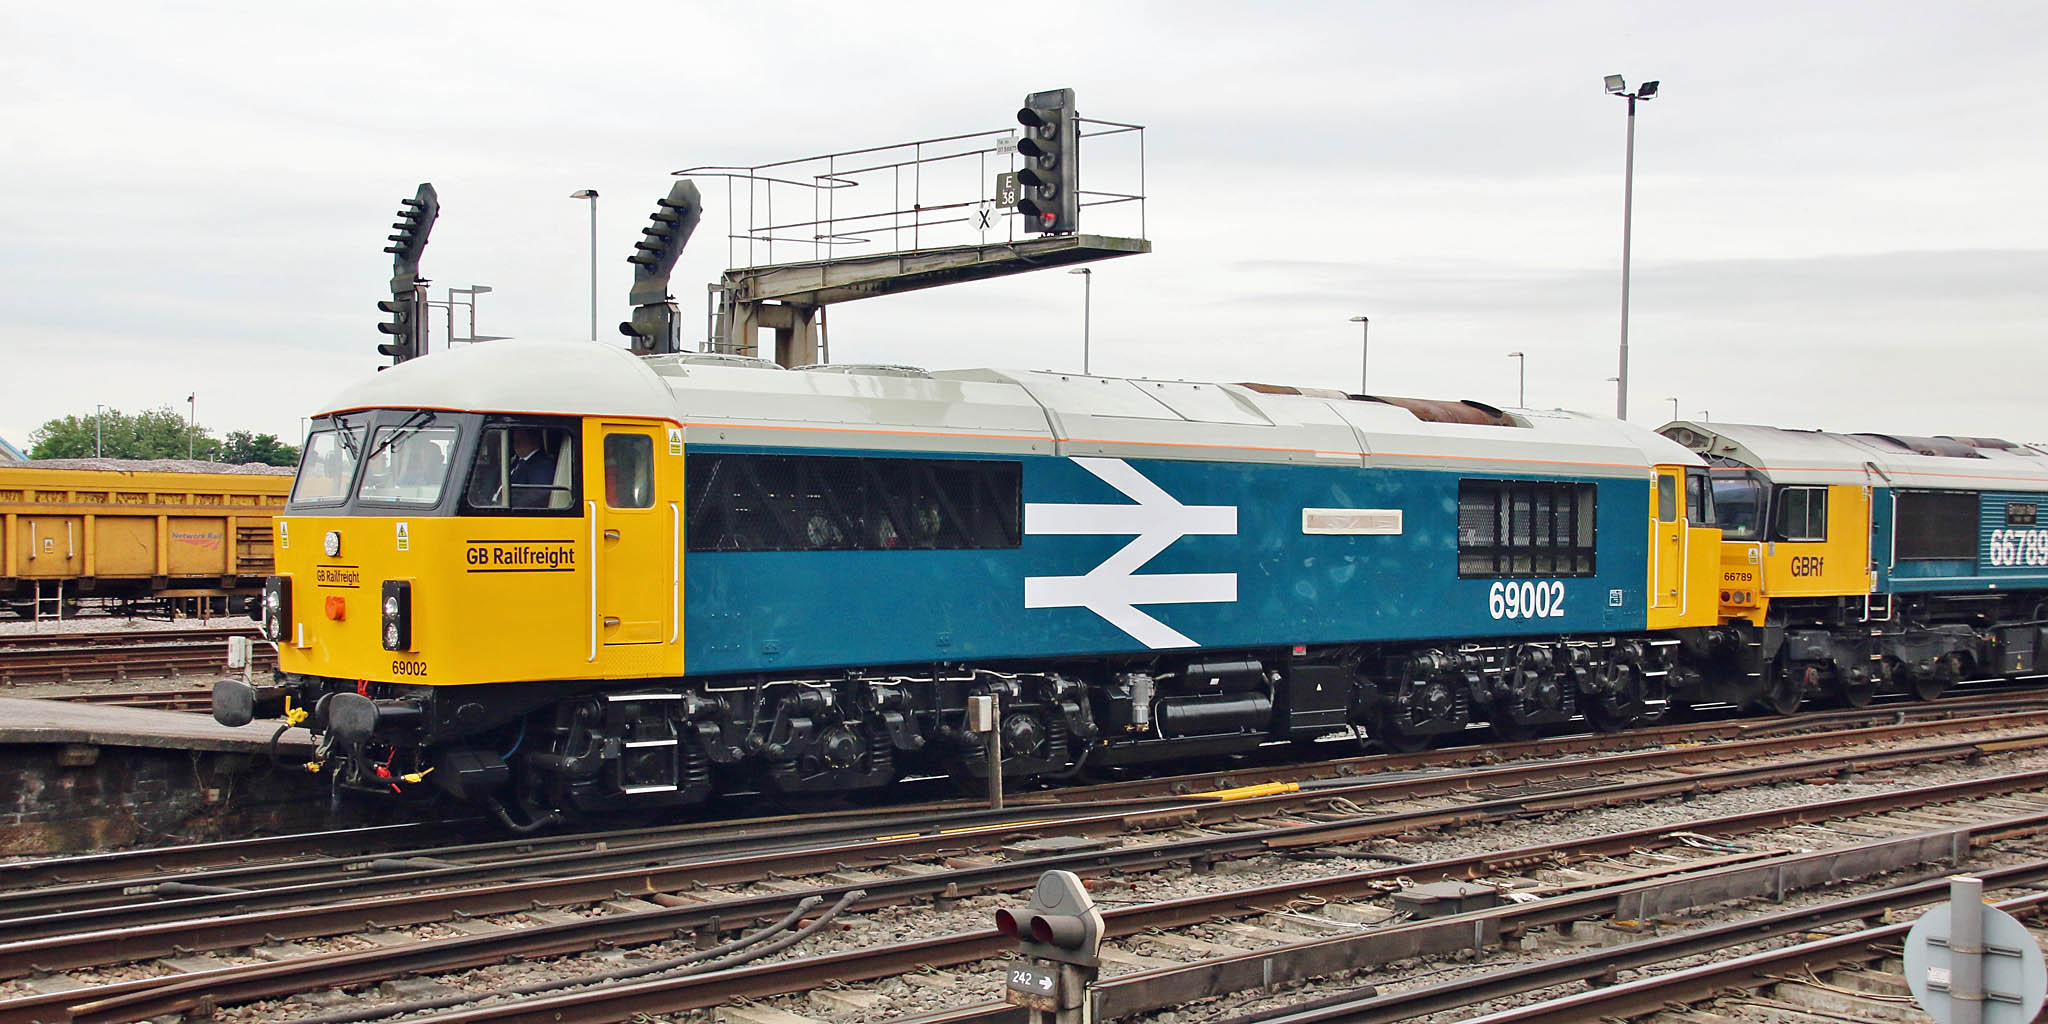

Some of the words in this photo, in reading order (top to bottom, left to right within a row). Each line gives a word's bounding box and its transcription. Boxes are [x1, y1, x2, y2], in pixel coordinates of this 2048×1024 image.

[1006, 175, 1013, 188] E
[1001, 191, 1015, 205] 38
[1990, 529, 2048, 566] 66789
[466, 547, 489, 565] GB
[493, 546, 575, 568] Railfreight
[1791, 556, 1824, 577] GBRf
[317, 569, 326, 582] GB
[326, 570, 360, 586] Railfreight
[1724, 572, 1752, 582] 66789
[1489, 580, 1565, 620] 69002
[392, 660, 428, 676] 69002
[1012, 970, 1032, 985] 242
